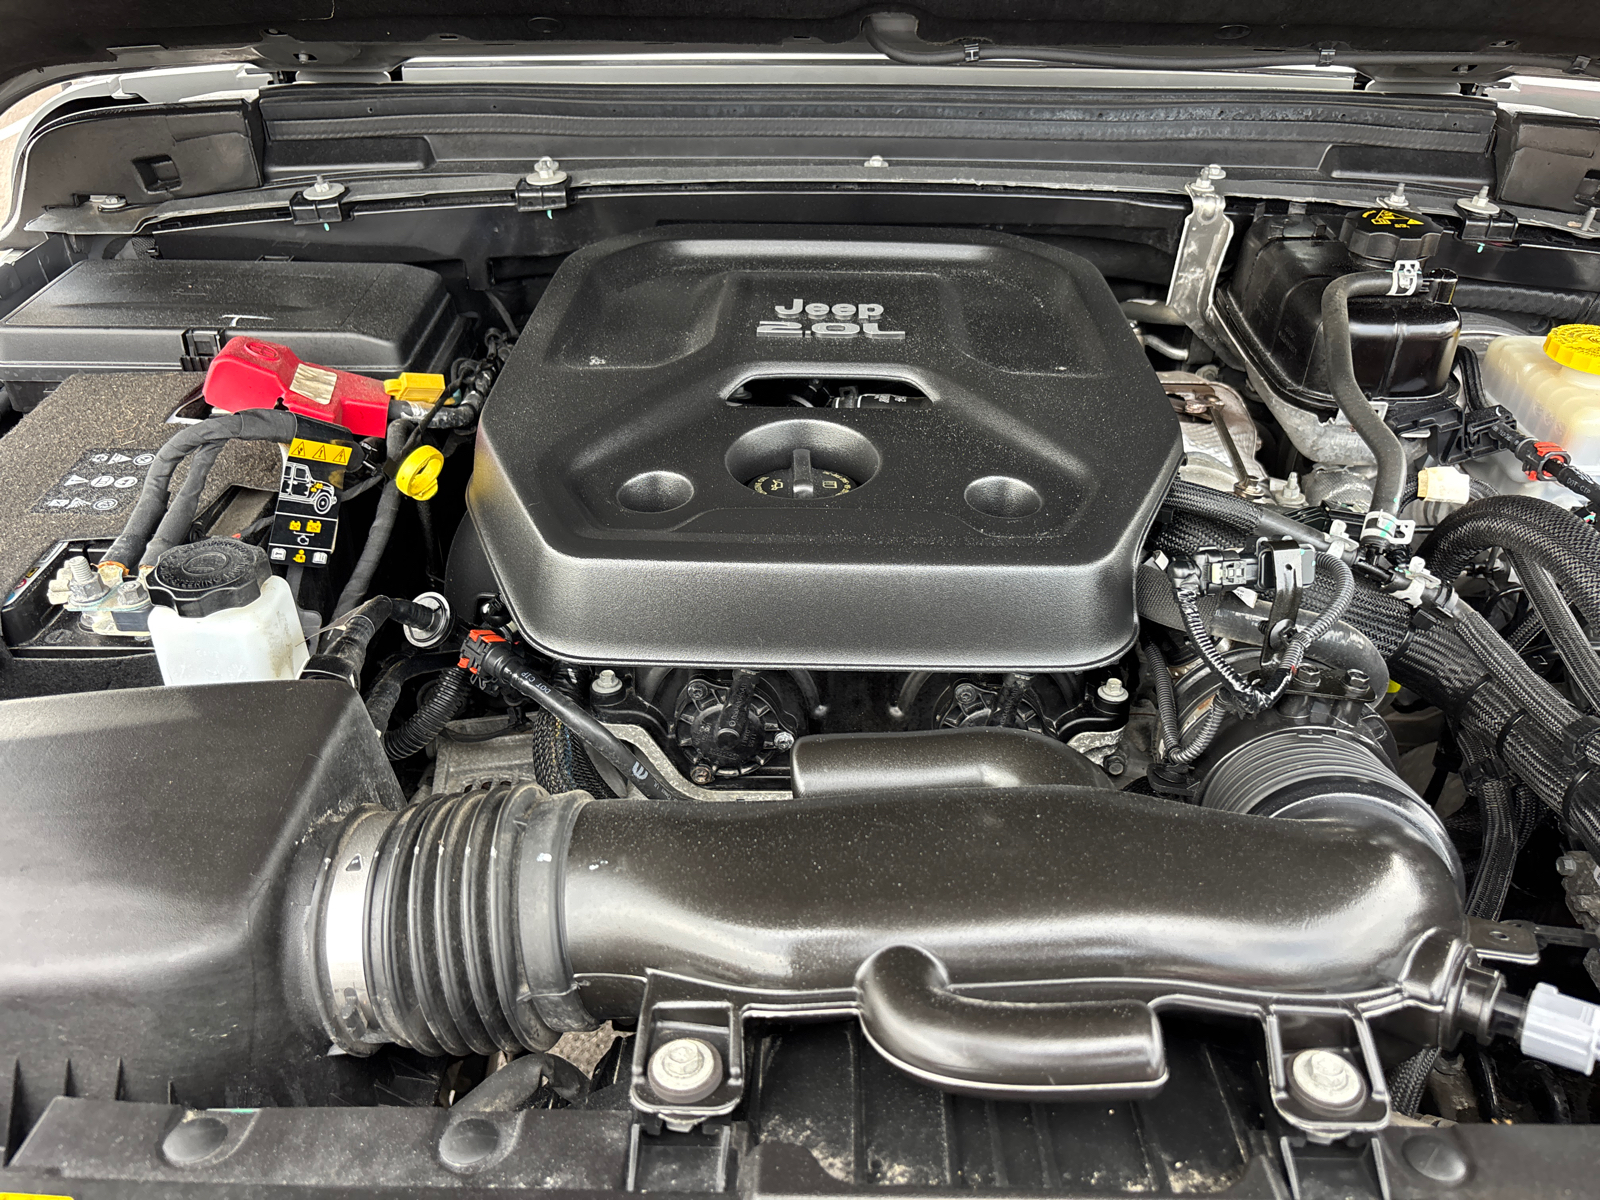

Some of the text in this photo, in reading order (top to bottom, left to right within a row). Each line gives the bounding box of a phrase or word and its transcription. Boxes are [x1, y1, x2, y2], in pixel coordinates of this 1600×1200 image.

[775, 299, 884, 320] Jeep
[756, 321, 905, 339] 2.0L
[520, 671, 551, 694] DOT CIP
